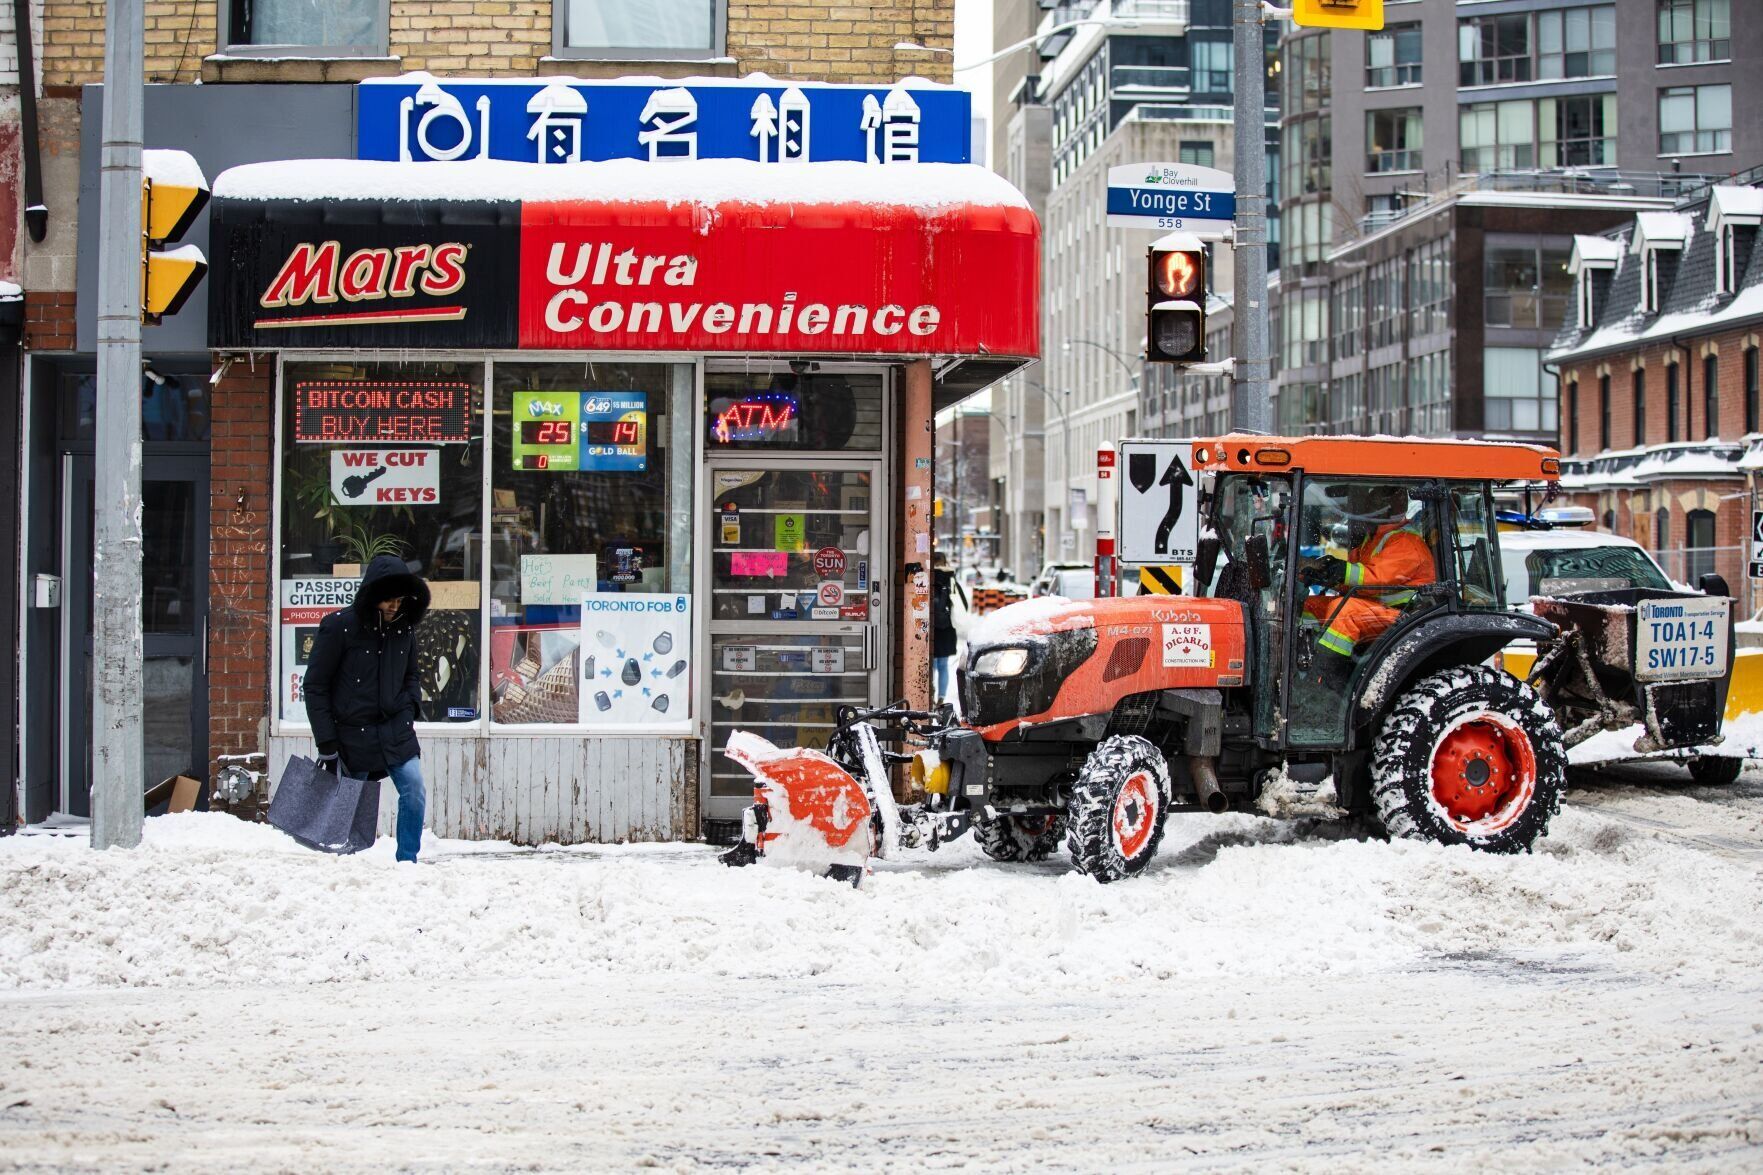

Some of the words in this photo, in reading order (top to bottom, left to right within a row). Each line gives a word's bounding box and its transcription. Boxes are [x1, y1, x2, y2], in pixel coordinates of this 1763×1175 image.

[1163, 168, 1179, 178] Bay
[1162, 176, 1198, 186] Cloverhill
[1129, 189, 1188, 214] Yonge
[1193, 192, 1211, 212] St
[1158, 218, 1182, 229] 558
[545, 242, 698, 286] Ultra
[259, 240, 468, 308] Mars
[545, 288, 941, 335] Convenience
[308, 391, 391, 409] BITCOIN
[396, 391, 453, 409] CASH
[621, 401, 644, 409] MILLION
[724, 405, 791, 429] ATM
[322, 416, 371, 436] BUY
[379, 416, 442, 436] HERE
[538, 422, 569, 442] 25
[614, 423, 637, 442] 14
[617, 447, 638, 456] BALL
[342, 452, 378, 467] WE
[385, 452, 428, 467] CUT
[538, 455, 548, 468] 0
[376, 487, 436, 502] KEYS
[524, 559, 545, 573] Hot
[816, 558, 844, 568] SUN
[530, 576, 553, 592] Beef
[563, 575, 590, 589] Patty
[585, 600, 645, 612] TORONTO
[647, 601, 672, 612] FOB
[1651, 604, 1684, 618] TORONTO
[290, 611, 320, 619] PHOTOS
[1151, 609, 1201, 622] Kubota
[1171, 627, 1182, 635] A.
[1183, 627, 1191, 635] &
[1193, 627, 1202, 635] F.
[1650, 620, 1714, 643] TOA1-4
[1165, 636, 1209, 651] DICARLO
[1648, 645, 1714, 669] SW17-5
